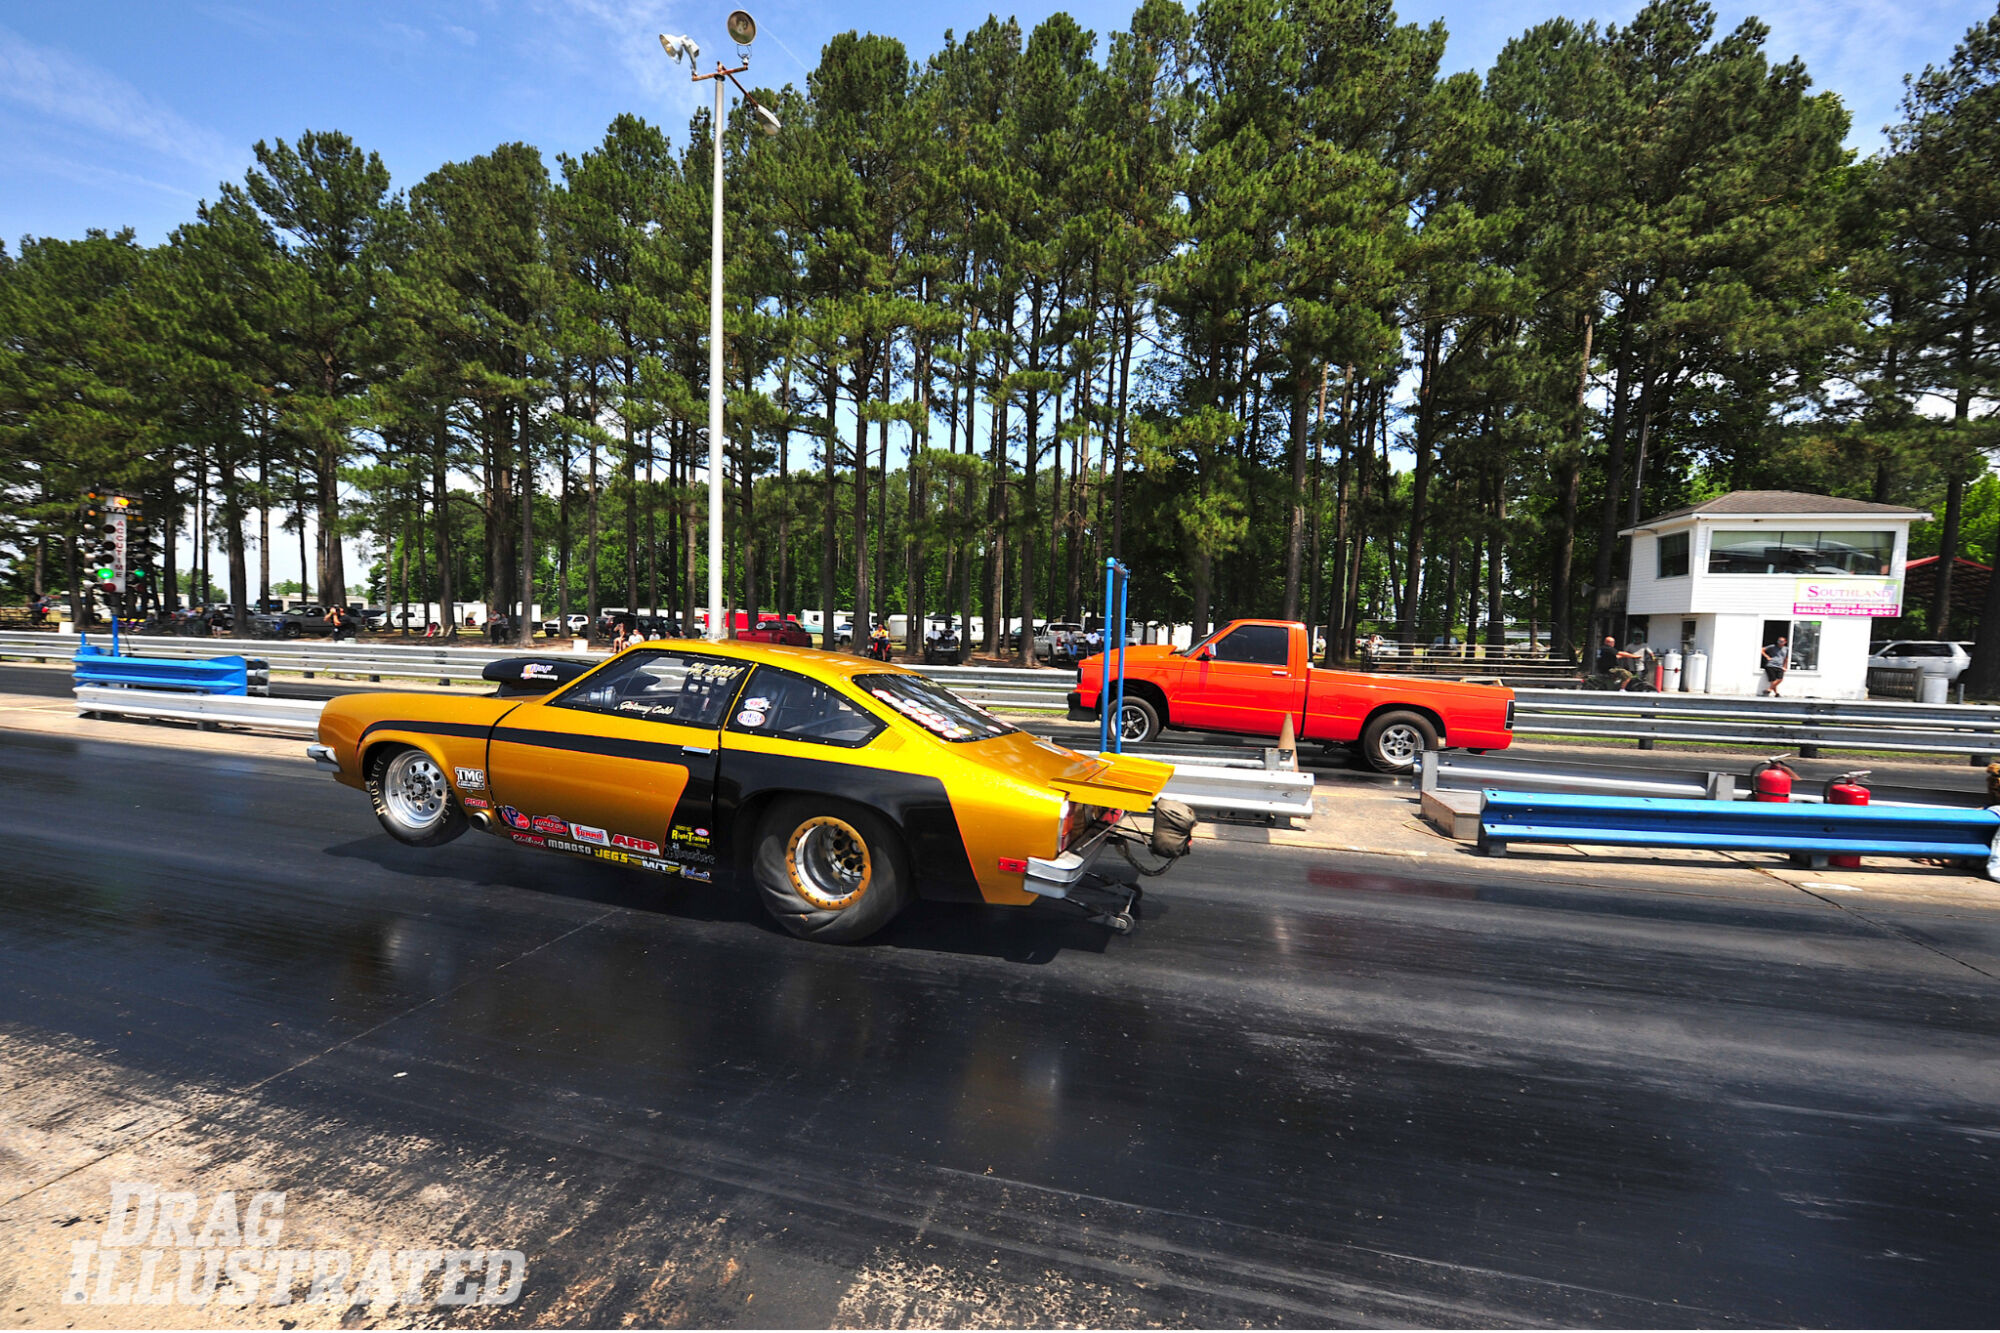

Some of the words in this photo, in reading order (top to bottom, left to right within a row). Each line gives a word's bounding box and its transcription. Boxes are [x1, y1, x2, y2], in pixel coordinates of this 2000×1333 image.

[101, 505, 142, 515] STAGE
[456, 769, 483, 782] TMC
[535, 820, 554, 828] LUCAS
[548, 839, 592, 855] MOROSO
[612, 834, 658, 851] ARP
